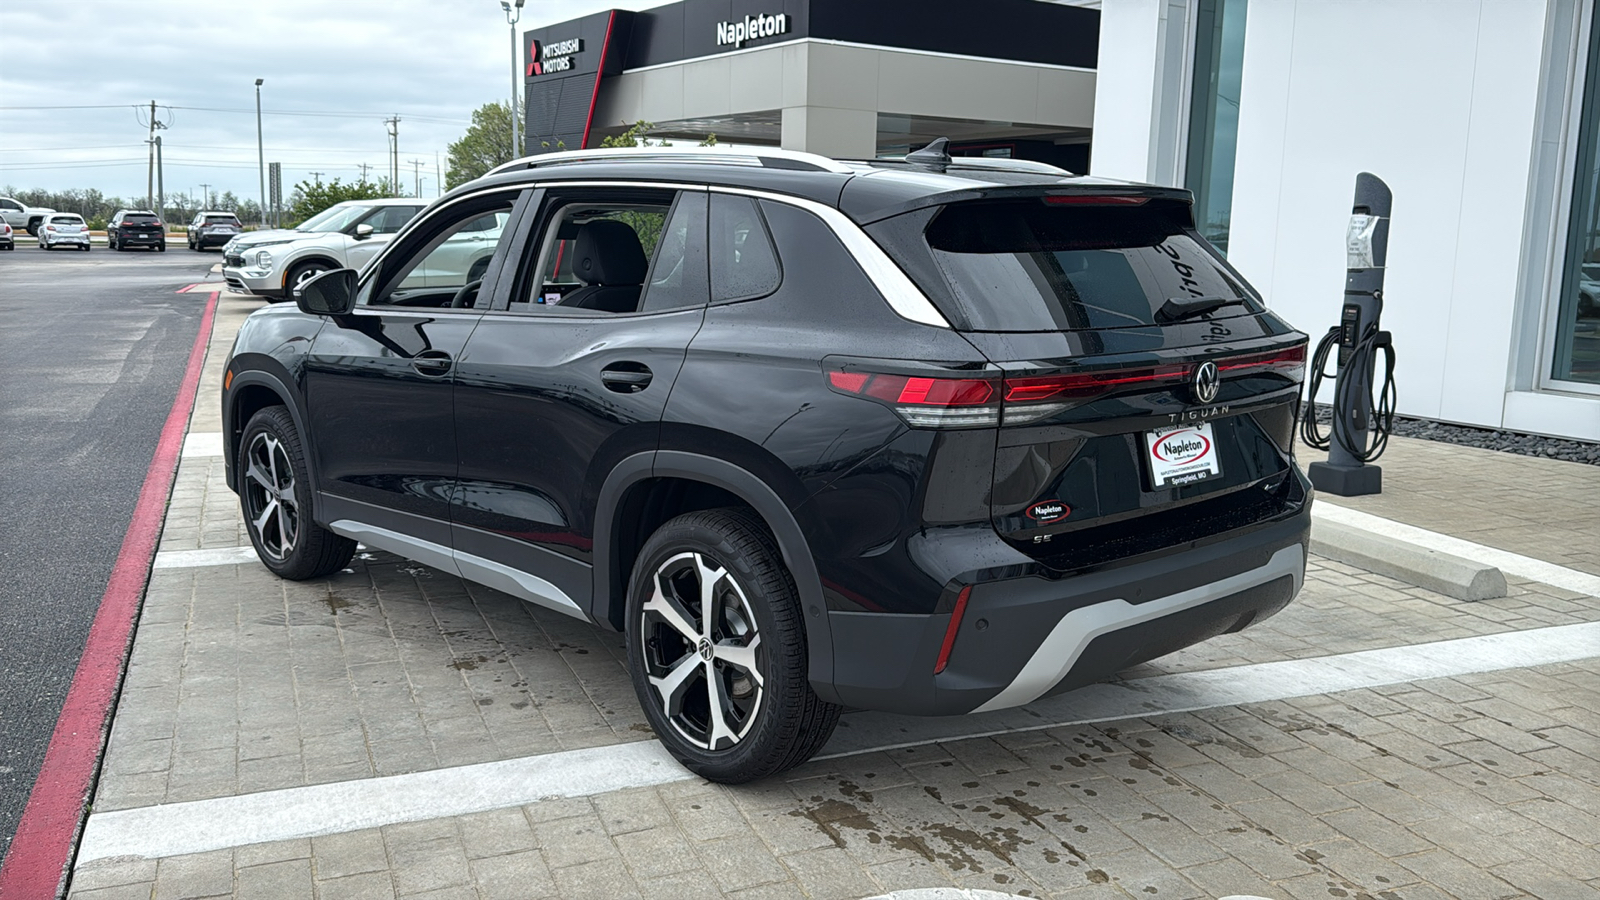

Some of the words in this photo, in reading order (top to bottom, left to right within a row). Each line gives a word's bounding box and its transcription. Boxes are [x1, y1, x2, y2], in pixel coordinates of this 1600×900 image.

[717, 13, 786, 48] Napleton
[542, 38, 580, 57] MITSUBISHI
[542, 57, 571, 74] MOTORS
[1168, 405, 1231, 423] TIGUAN
[1164, 439, 1203, 456] Napleton
[1035, 505, 1062, 515] Napleton
[1033, 534, 1053, 544] SE
